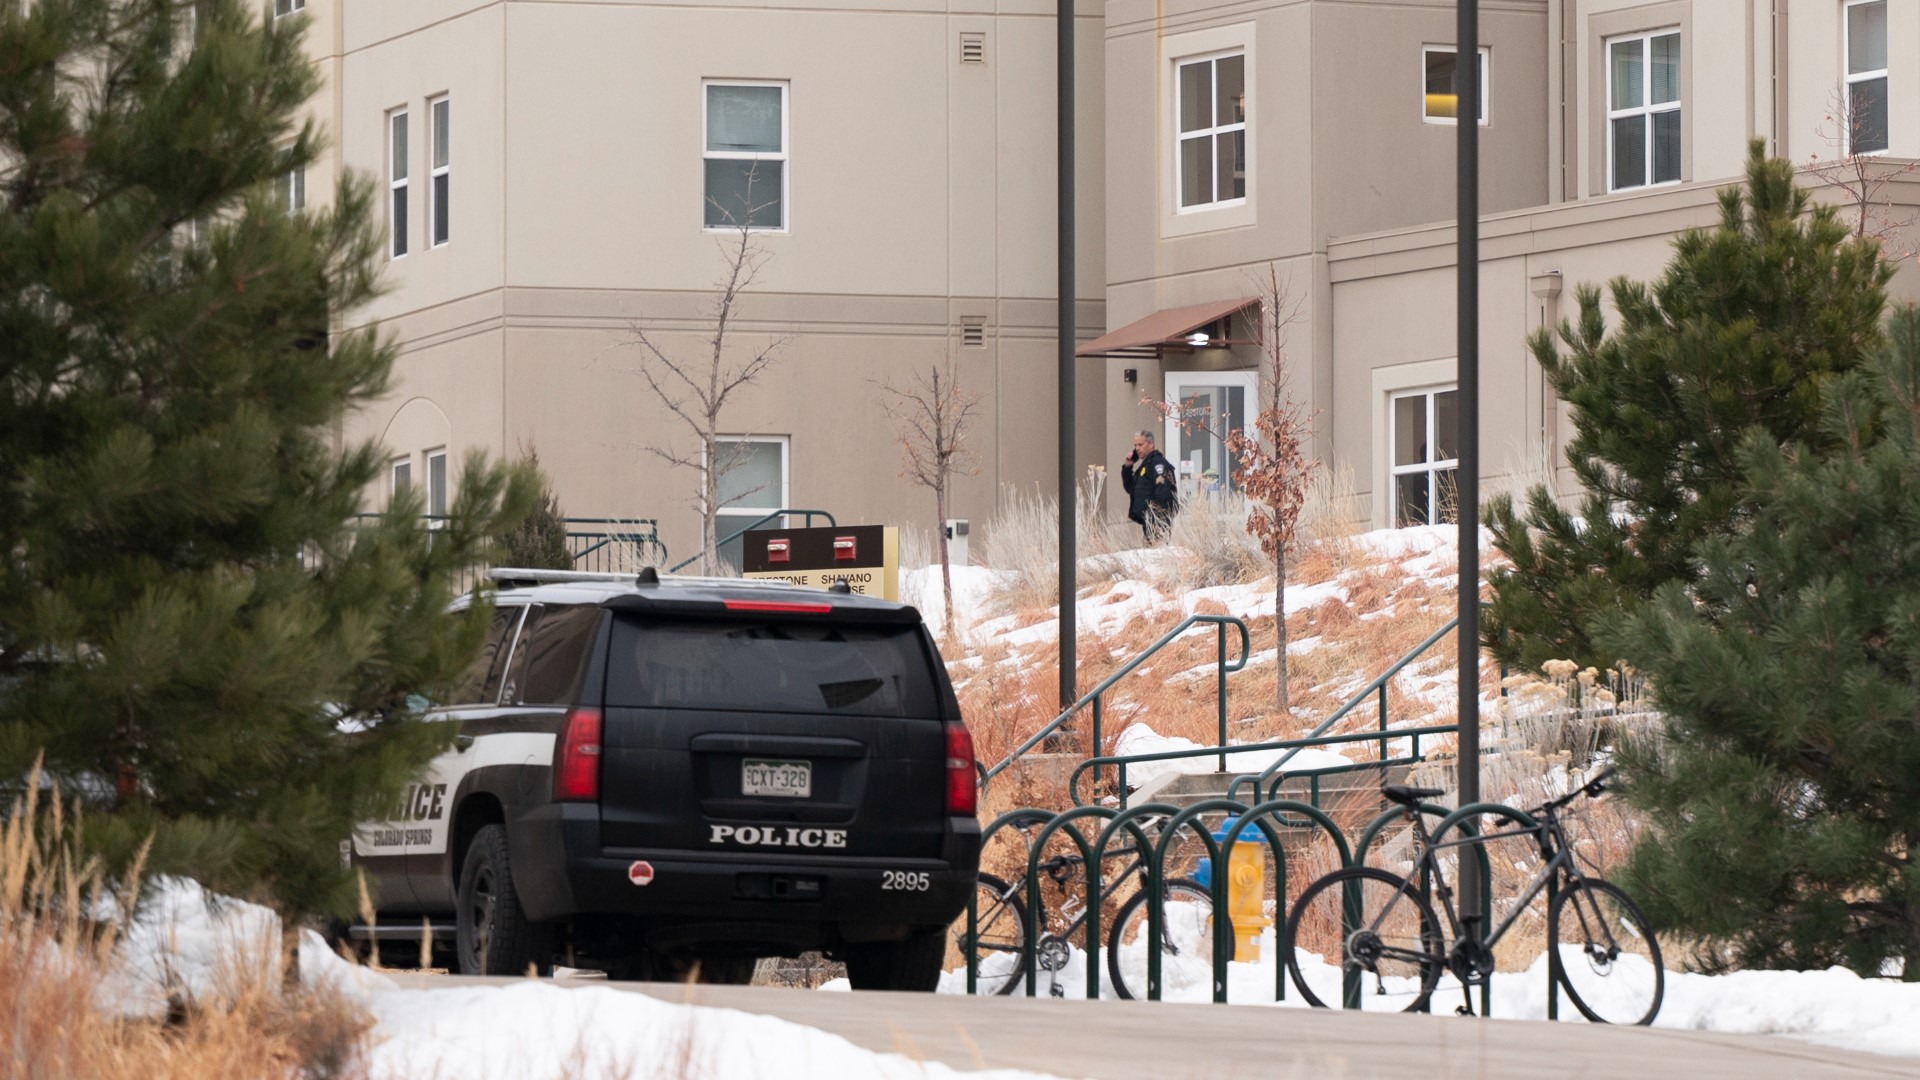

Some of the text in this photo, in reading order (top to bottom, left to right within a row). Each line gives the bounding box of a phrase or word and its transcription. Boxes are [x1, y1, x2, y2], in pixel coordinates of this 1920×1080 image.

[390, 783, 448, 821] ICE
[709, 824, 847, 848] POLICE
[881, 870, 930, 891] 2895
